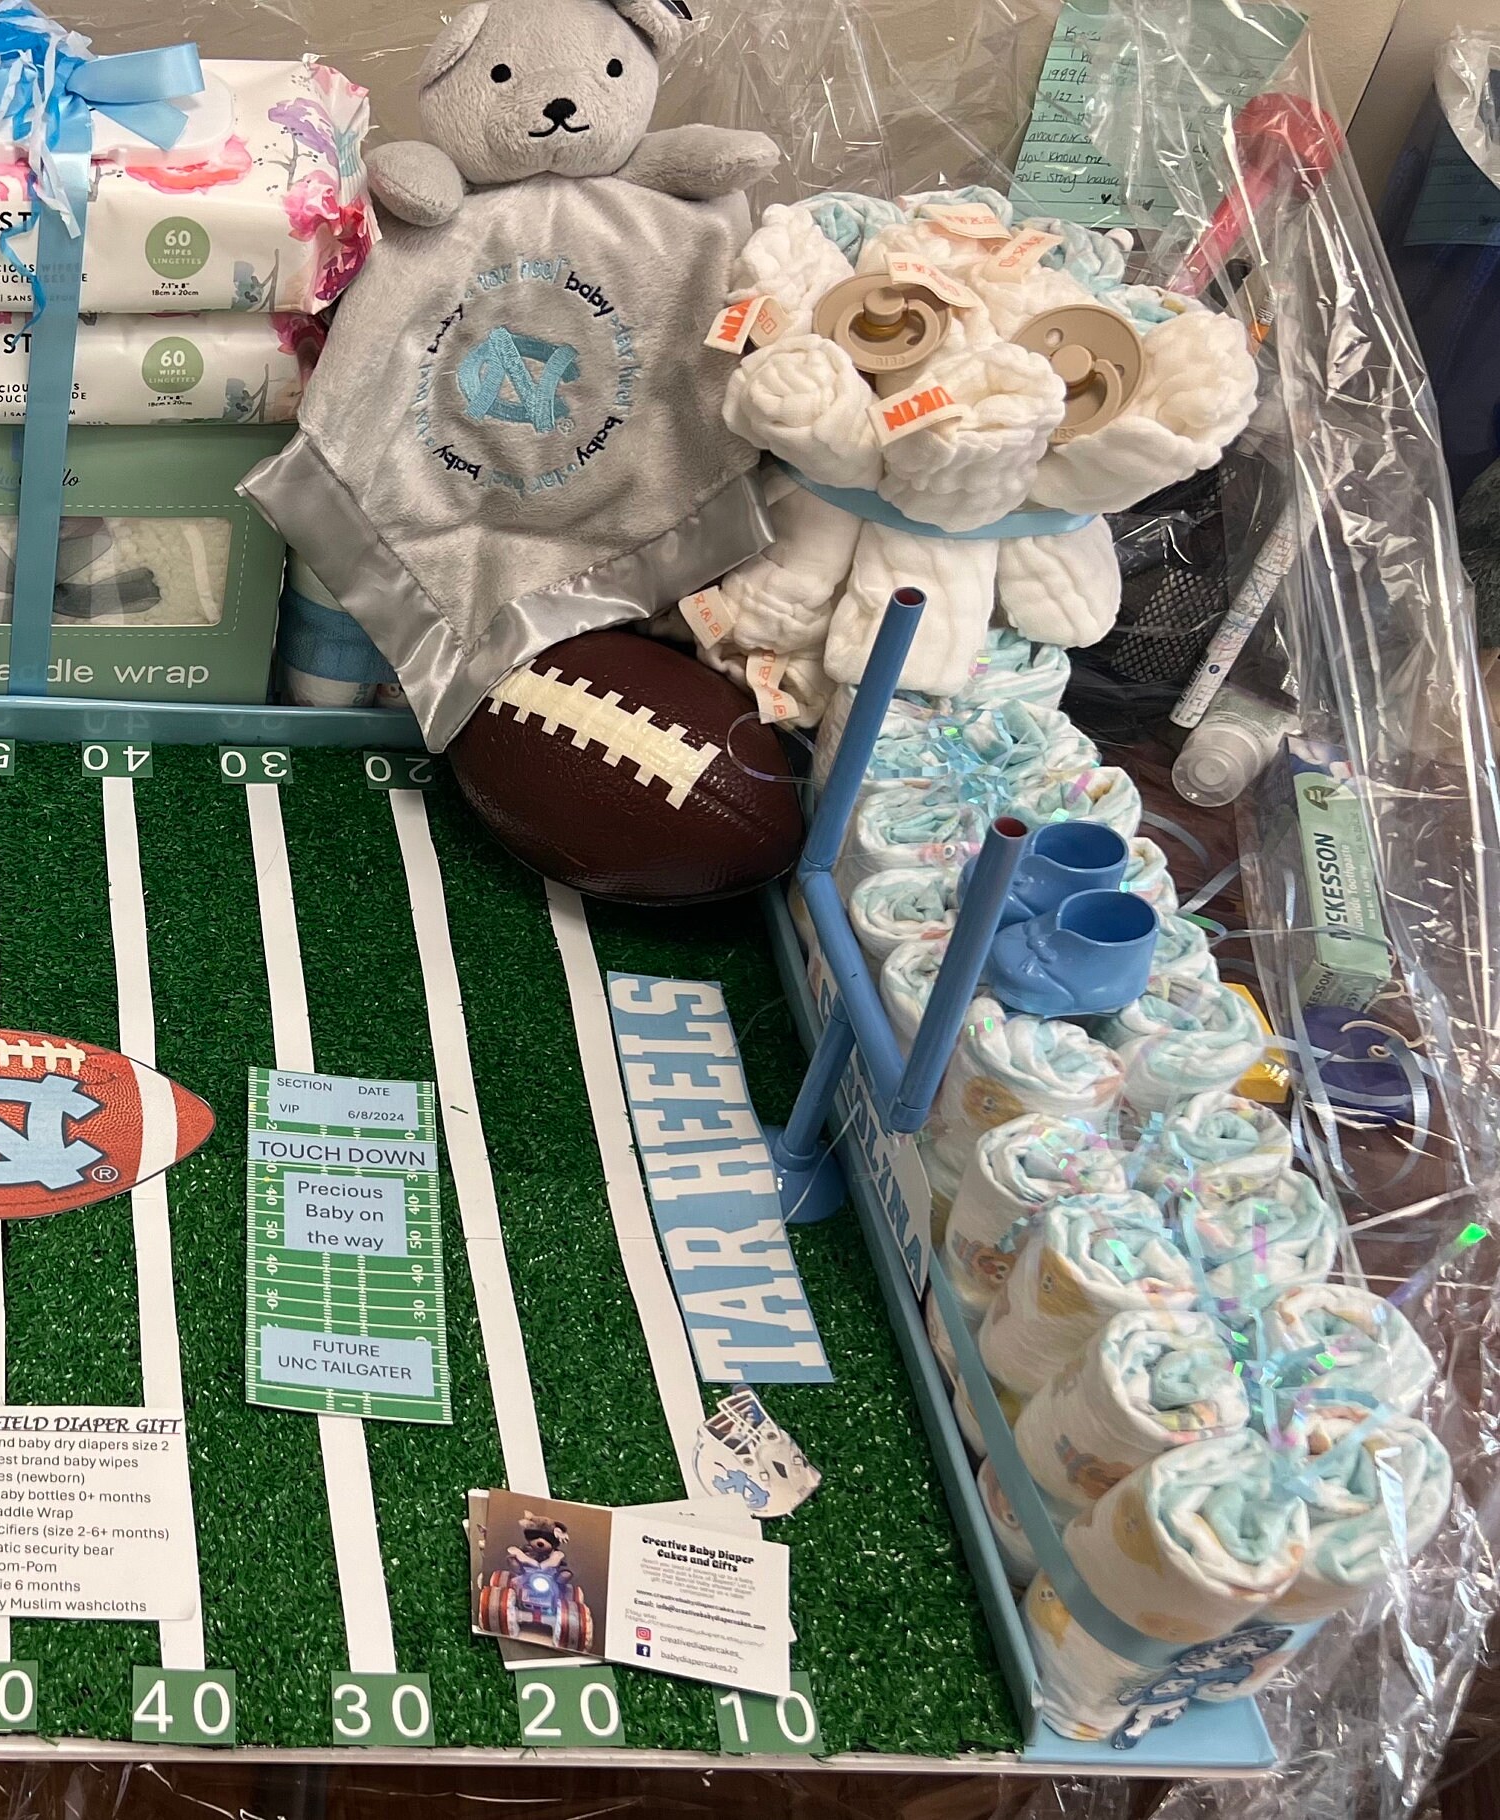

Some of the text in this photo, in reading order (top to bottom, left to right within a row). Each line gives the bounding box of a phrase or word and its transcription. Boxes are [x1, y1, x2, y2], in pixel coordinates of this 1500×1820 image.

[164, 230, 191, 247] 60
[564, 271, 615, 318] baby
[160, 350, 185, 367] 60
[576, 415, 624, 466] baby
[433, 444, 482, 480] baby
[114, 660, 209, 688] wrap
[82, 744, 152, 773] 40
[221, 748, 289, 778] 30
[366, 754, 432, 783] 20
[276, 1077, 391, 1097] SECTION DATE
[610, 978, 775, 1202] HEELS
[279, 1103, 405, 1123] VIP 6/8/2024
[258, 1140, 426, 1167] TOUCH DOWN
[297, 1179, 384, 1200] Precious
[305, 1203, 385, 1223] Baby on
[307, 1229, 385, 1252] the way
[664, 1218, 826, 1382] TAR
[313, 1339, 381, 1358] FUTURE
[278, 1355, 413, 1381] UNC TAILGATER
[53, 1416, 131, 1433] DIAPER
[135, 1418, 184, 1434] GIFT
[18, 1437, 51, 1450] baby
[54, 1438, 75, 1451] dry
[78, 1438, 129, 1452] diapers
[132, 1440, 158, 1451] size
[21, 1454, 60, 1466] brand
[64, 1455, 96, 1469] baby
[99, 1457, 139, 1470] wipes
[16, 1472, 85, 1486] (newborn)
[28, 1489, 75, 1501] bottles
[78, 1490, 96, 1501] 0+
[99, 1491, 152, 1504] months
[37, 1507, 74, 1520] Wrap
[43, 1525, 74, 1538] (size
[77, 1526, 108, 1538] 2-6+
[112, 1527, 170, 1541] months)
[24, 1542, 80, 1557] security
[83, 1544, 115, 1556] bear
[642, 1535, 754, 1565] Creative Baby Diaper
[657, 1549, 739, 1573] Cakes and Gifts
[27, 1580, 81, 1592] months
[10, 1597, 62, 1610] Muslim
[65, 1599, 147, 1612] washcloths
[133, 1678, 232, 1738] 40
[332, 1681, 431, 1740] 30
[520, 1681, 620, 1737] 20
[718, 1689, 817, 1745] 10
